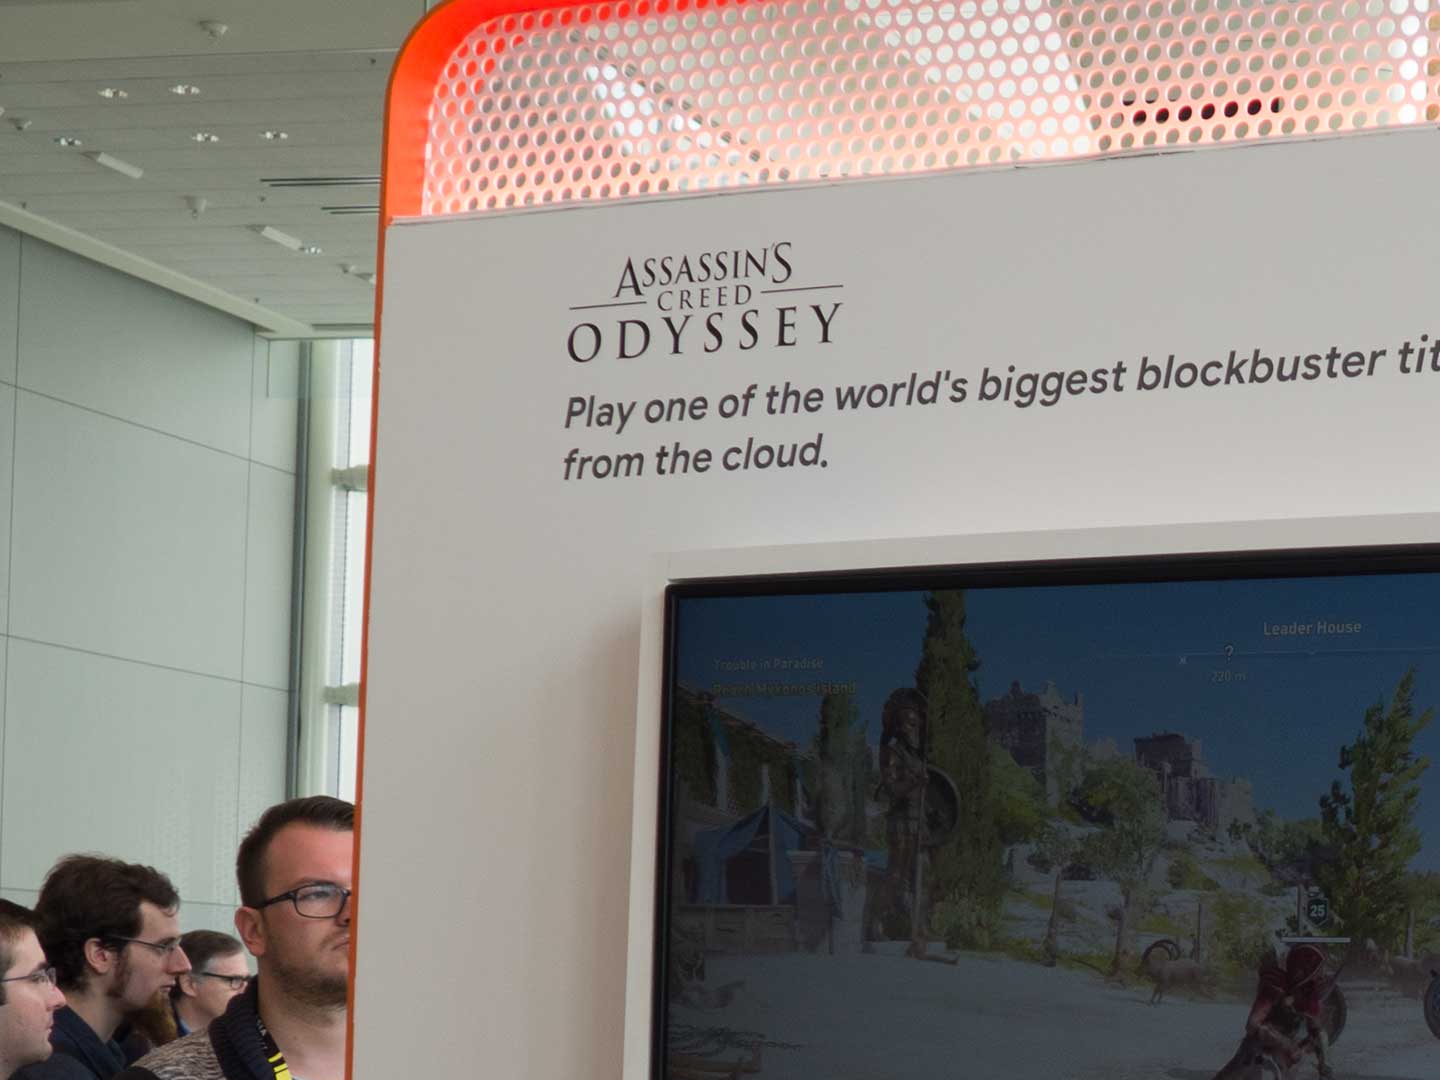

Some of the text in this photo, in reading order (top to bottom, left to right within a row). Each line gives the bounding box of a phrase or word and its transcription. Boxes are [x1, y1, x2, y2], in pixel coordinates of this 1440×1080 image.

[614, 241, 793, 299] ASSASSIN'S
[657, 284, 753, 312] CREED
[566, 301, 844, 363] ODYSSEY
[564, 395, 637, 435] Play
[644, 396, 709, 424] one
[718, 383, 758, 419] of
[765, 381, 824, 415] the
[835, 370, 969, 411] world's
[978, 360, 1127, 409] biggest
[1136, 346, 1387, 391] blockbuster
[563, 432, 828, 481] from the cloud.
[1263, 621, 1362, 636] Leader House
[773, 656, 824, 671] Paradise
[1310, 904, 1326, 917] 25
